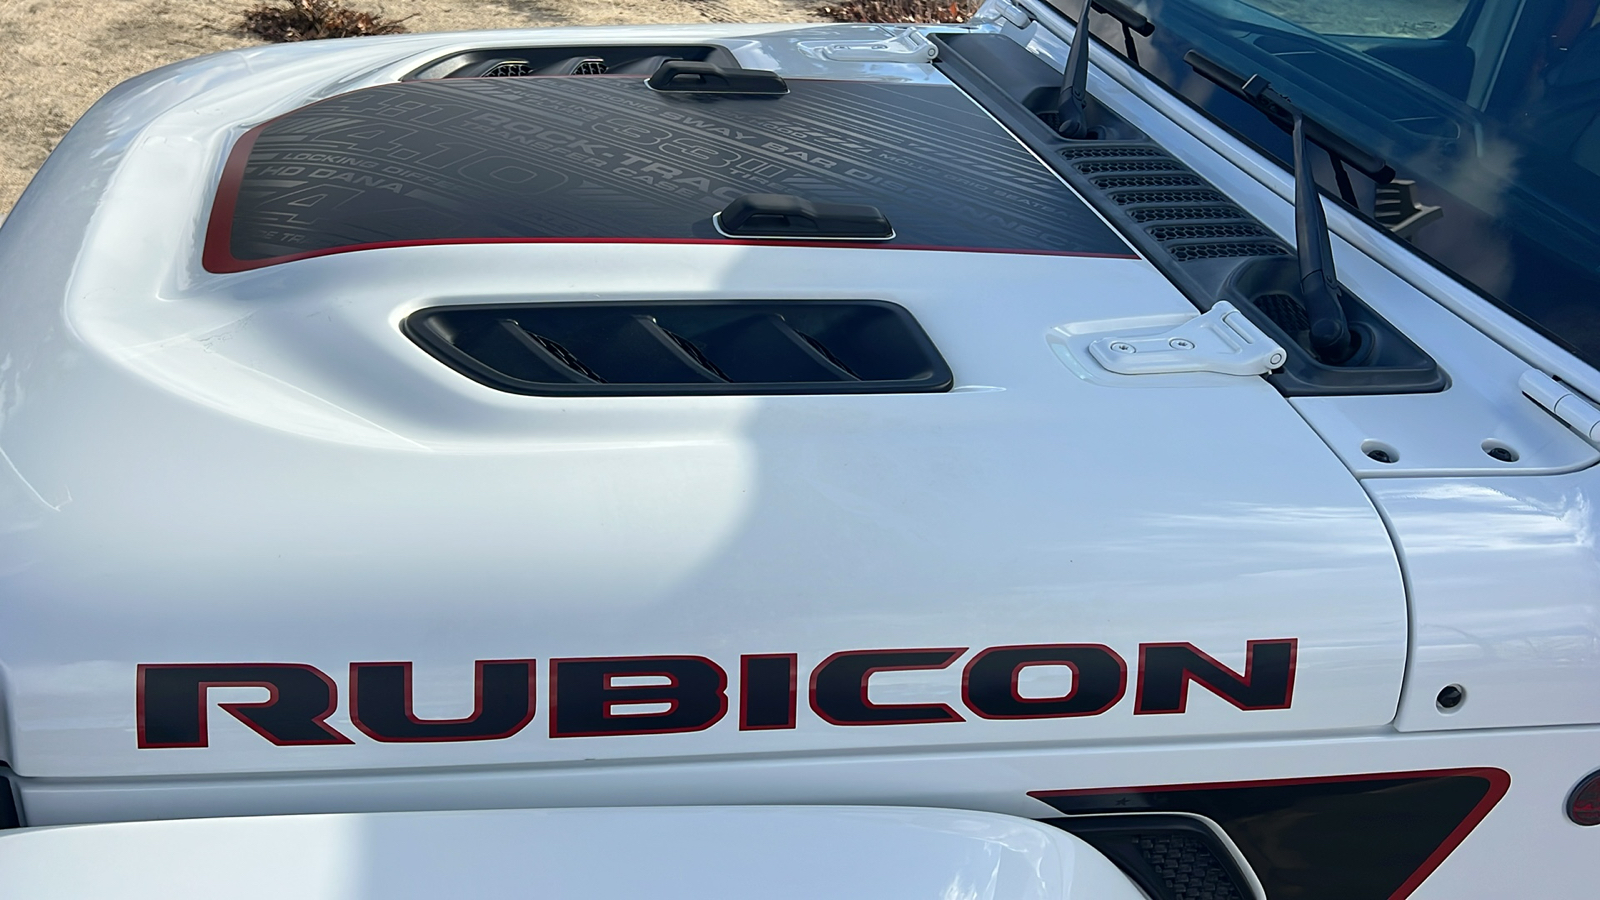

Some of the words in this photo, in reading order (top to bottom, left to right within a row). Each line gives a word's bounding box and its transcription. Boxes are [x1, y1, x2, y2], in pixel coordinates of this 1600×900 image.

[309, 122, 569, 195] 4.10
[461, 121, 608, 168] TRANSFER
[612, 167, 698, 198] CASE
[536, 79, 659, 112] ELECTRONIC
[659, 110, 757, 140] SWAY
[761, 141, 838, 169] BAR
[257, 165, 306, 177] HD
[308, 166, 407, 194] DANA
[282, 152, 380, 170] LOCKING
[943, 174, 989, 191] GRID
[136, 638, 1298, 749] RUBICON
